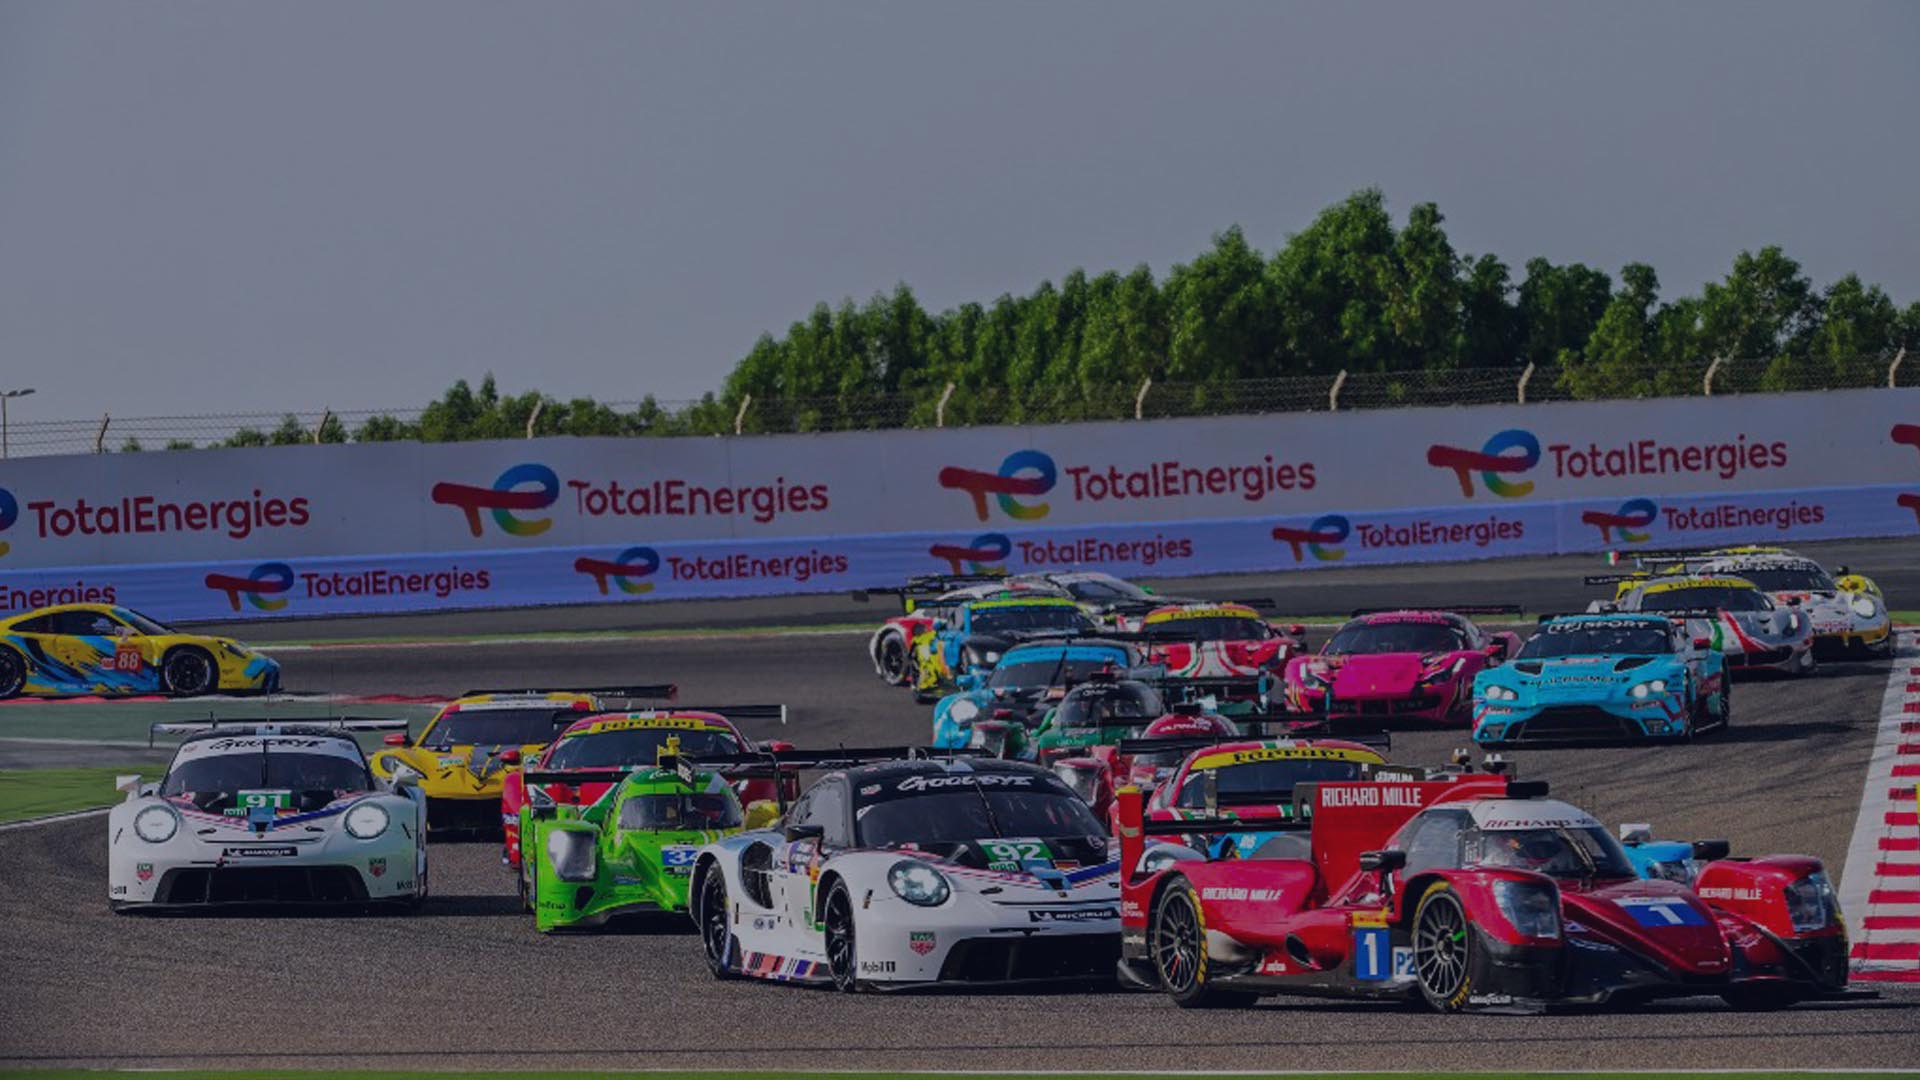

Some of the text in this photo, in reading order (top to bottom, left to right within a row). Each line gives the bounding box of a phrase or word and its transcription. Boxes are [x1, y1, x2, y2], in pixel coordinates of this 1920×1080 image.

[1549, 433, 1787, 480] TotalEnergies
[1066, 456, 1315, 502] TotalEnergies
[28, 490, 309, 539] TotalEnergies
[568, 478, 829, 523] TotalEnergies
[1662, 501, 1824, 530] TotalEnergies
[1356, 516, 1523, 548] TotalEnergies
[1018, 535, 1192, 566] TotalEnergies
[302, 566, 490, 598] TotalEnergies
[667, 551, 847, 583] TotalEnergies
[118, 652, 138, 669] 88
[246, 795, 282, 808] 91
[1322, 786, 1422, 808] RICHARD MILLE
[991, 843, 1050, 861] 92
[1202, 887, 1285, 900] RICHARD MILLE
[1734, 888, 1762, 900] MILLE
[1647, 904, 1685, 925] 1
[1364, 932, 1378, 976] 1
